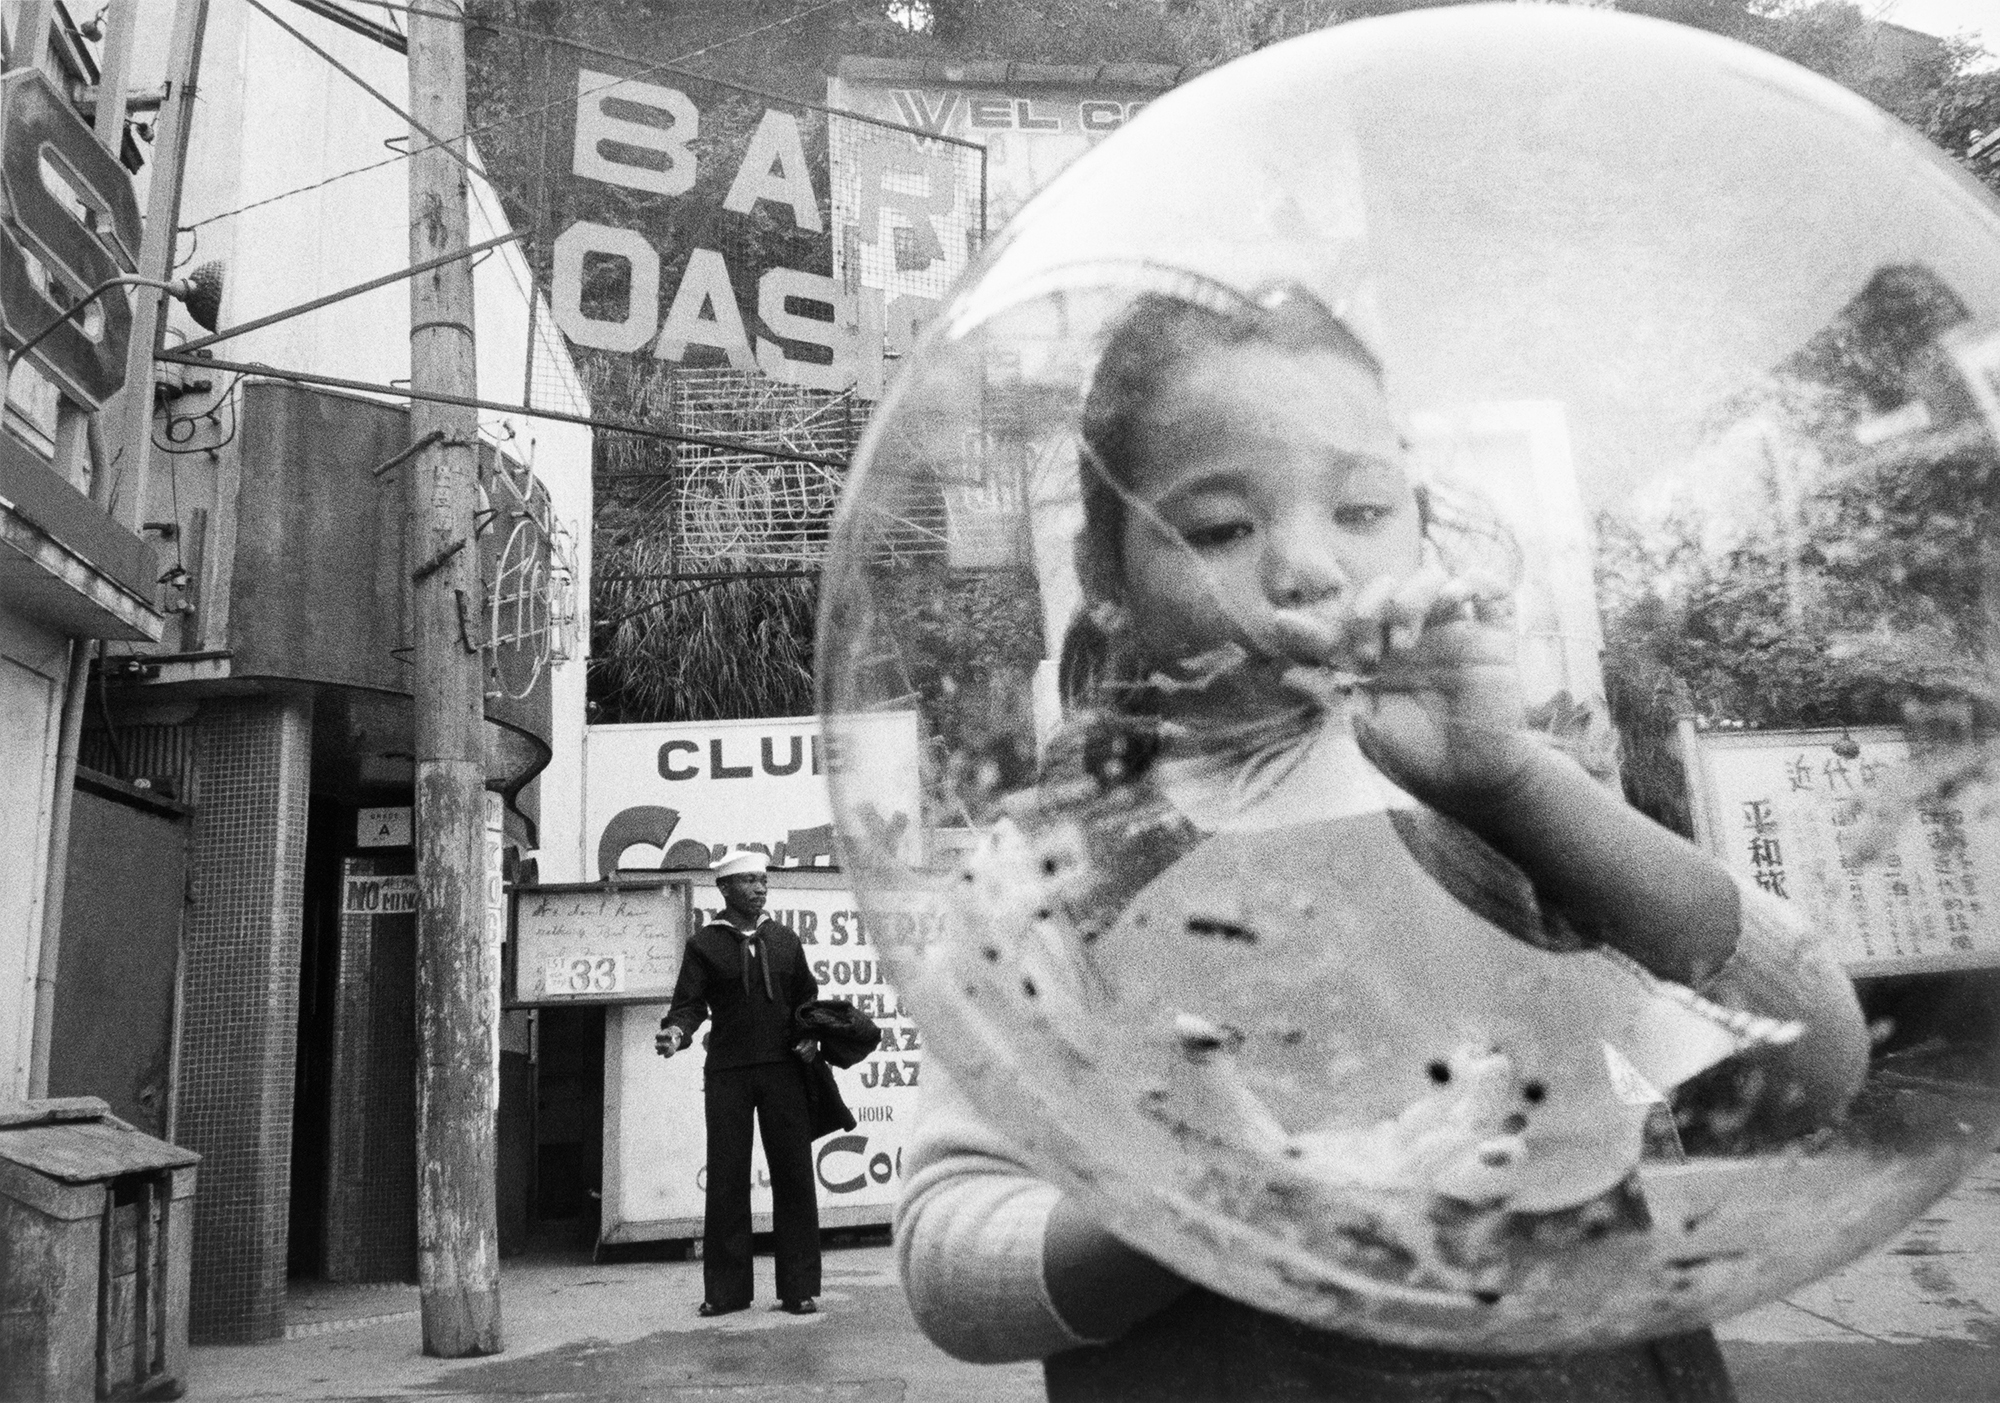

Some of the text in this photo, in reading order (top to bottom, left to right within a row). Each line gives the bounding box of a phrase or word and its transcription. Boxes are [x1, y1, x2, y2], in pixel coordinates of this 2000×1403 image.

[378, 823, 391, 836] A
[347, 881, 380, 911] NO
[382, 892, 416, 911] MIN
[568, 957, 617, 991] 33
[858, 1106, 894, 1122] HOUR
[816, 1135, 903, 1194] Co
